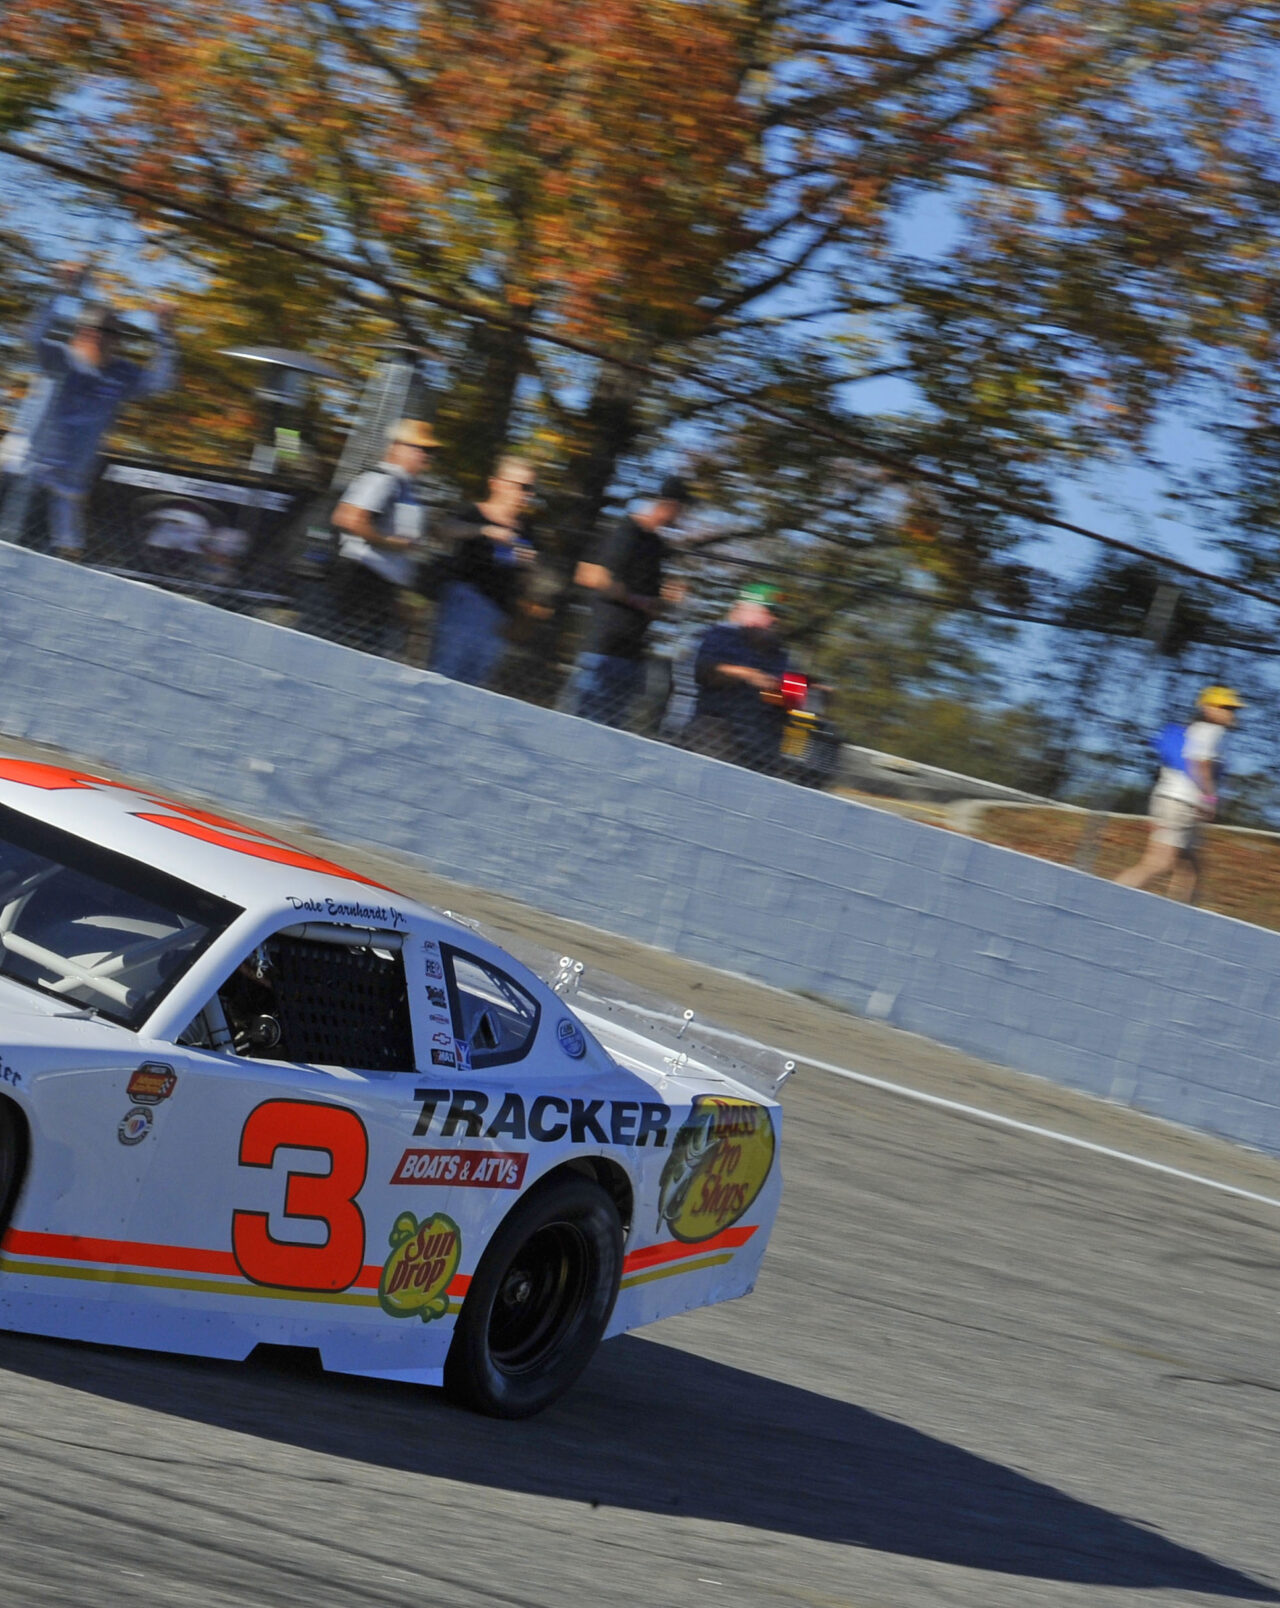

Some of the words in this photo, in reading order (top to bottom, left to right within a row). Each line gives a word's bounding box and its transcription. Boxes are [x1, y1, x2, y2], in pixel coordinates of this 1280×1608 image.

[285, 896, 323, 912] Dale
[324, 898, 388, 921] Earnhardt
[389, 906, 408, 928] Jr.
[412, 1088, 670, 1148] TRACKER
[399, 1154, 461, 1181] BOATS
[459, 1160, 471, 1182] &
[231, 1097, 370, 1294] 3
[690, 1173, 750, 1225] Shops
[404, 1223, 457, 1262] Sun
[384, 1258, 447, 1296] Drop
